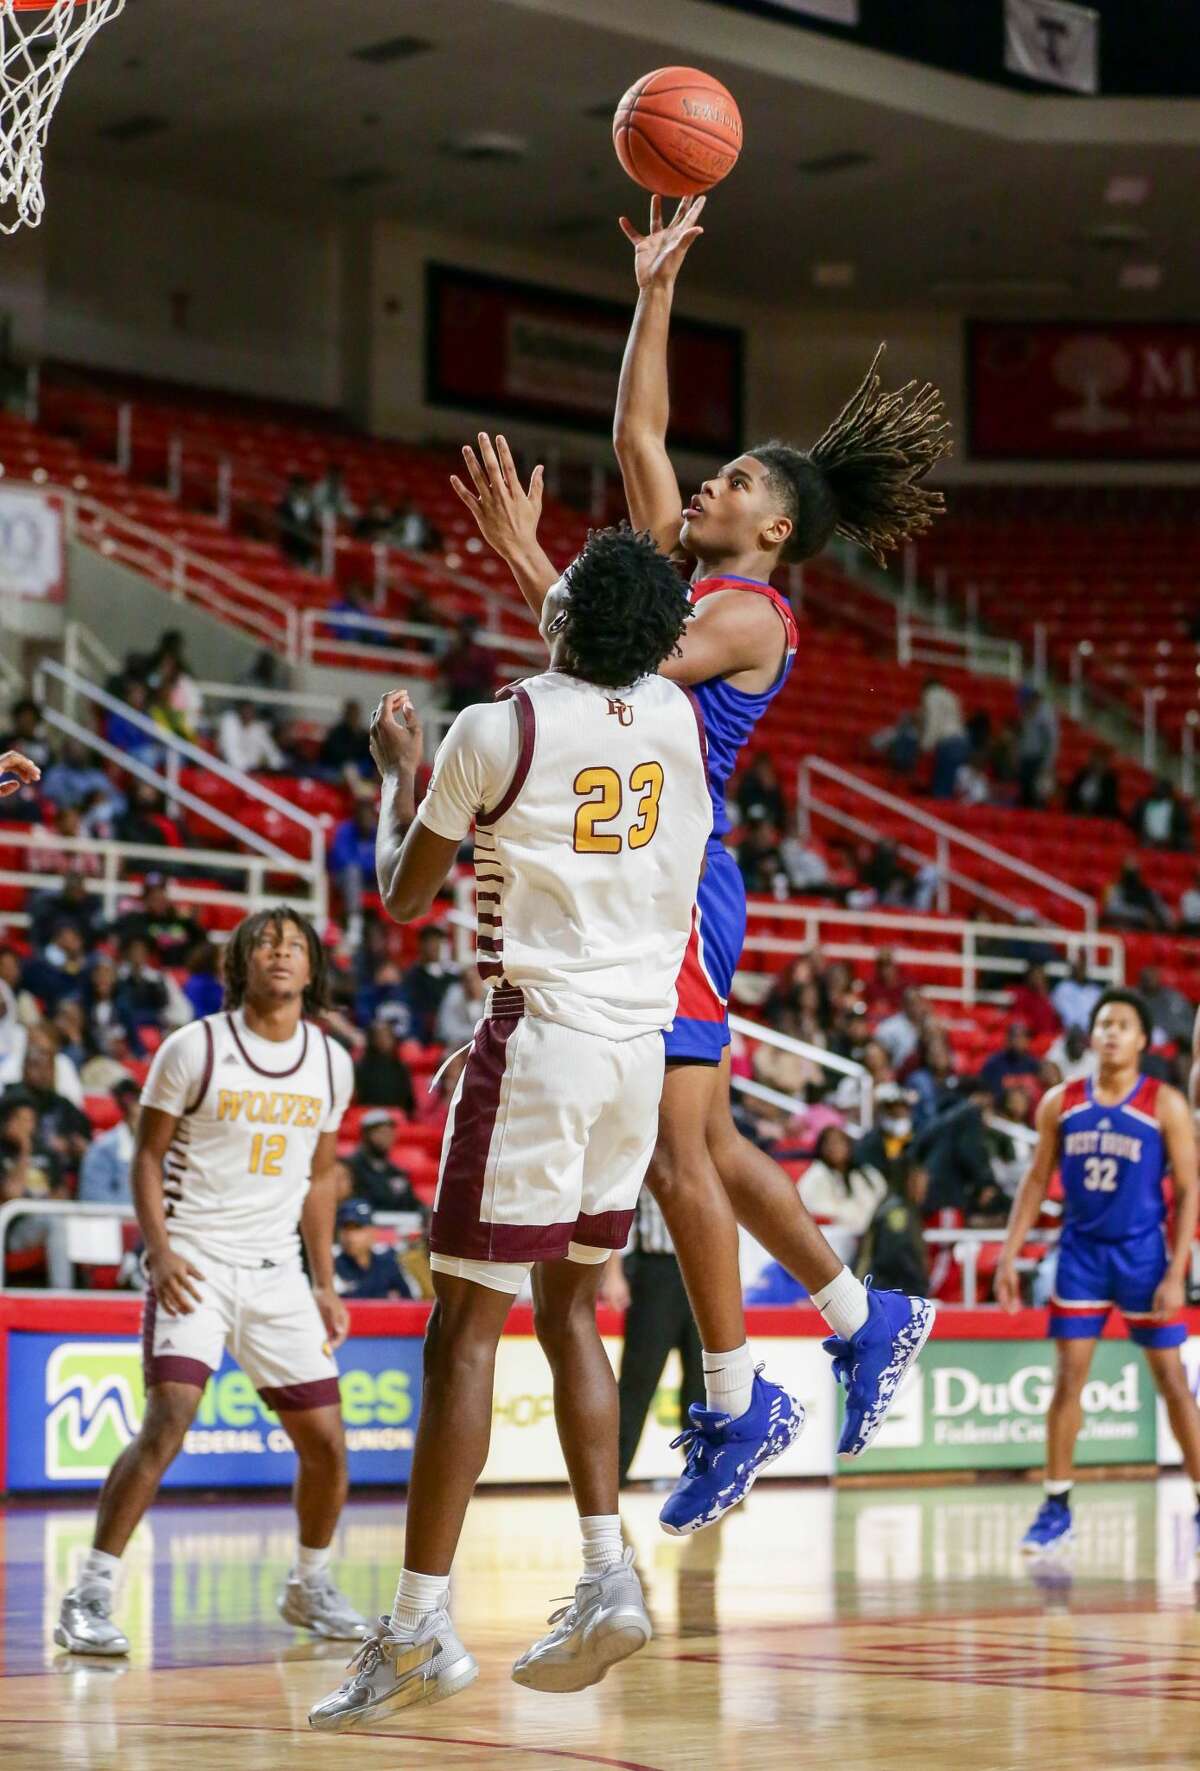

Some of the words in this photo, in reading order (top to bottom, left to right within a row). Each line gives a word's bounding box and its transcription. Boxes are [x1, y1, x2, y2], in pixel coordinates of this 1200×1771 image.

[573, 761, 664, 854] 23
[217, 1088, 322, 1128] WOLVES
[248, 1133, 286, 1176] 12
[1083, 1156, 1118, 1192] 32
[931, 1363, 1143, 1417] DuGod
